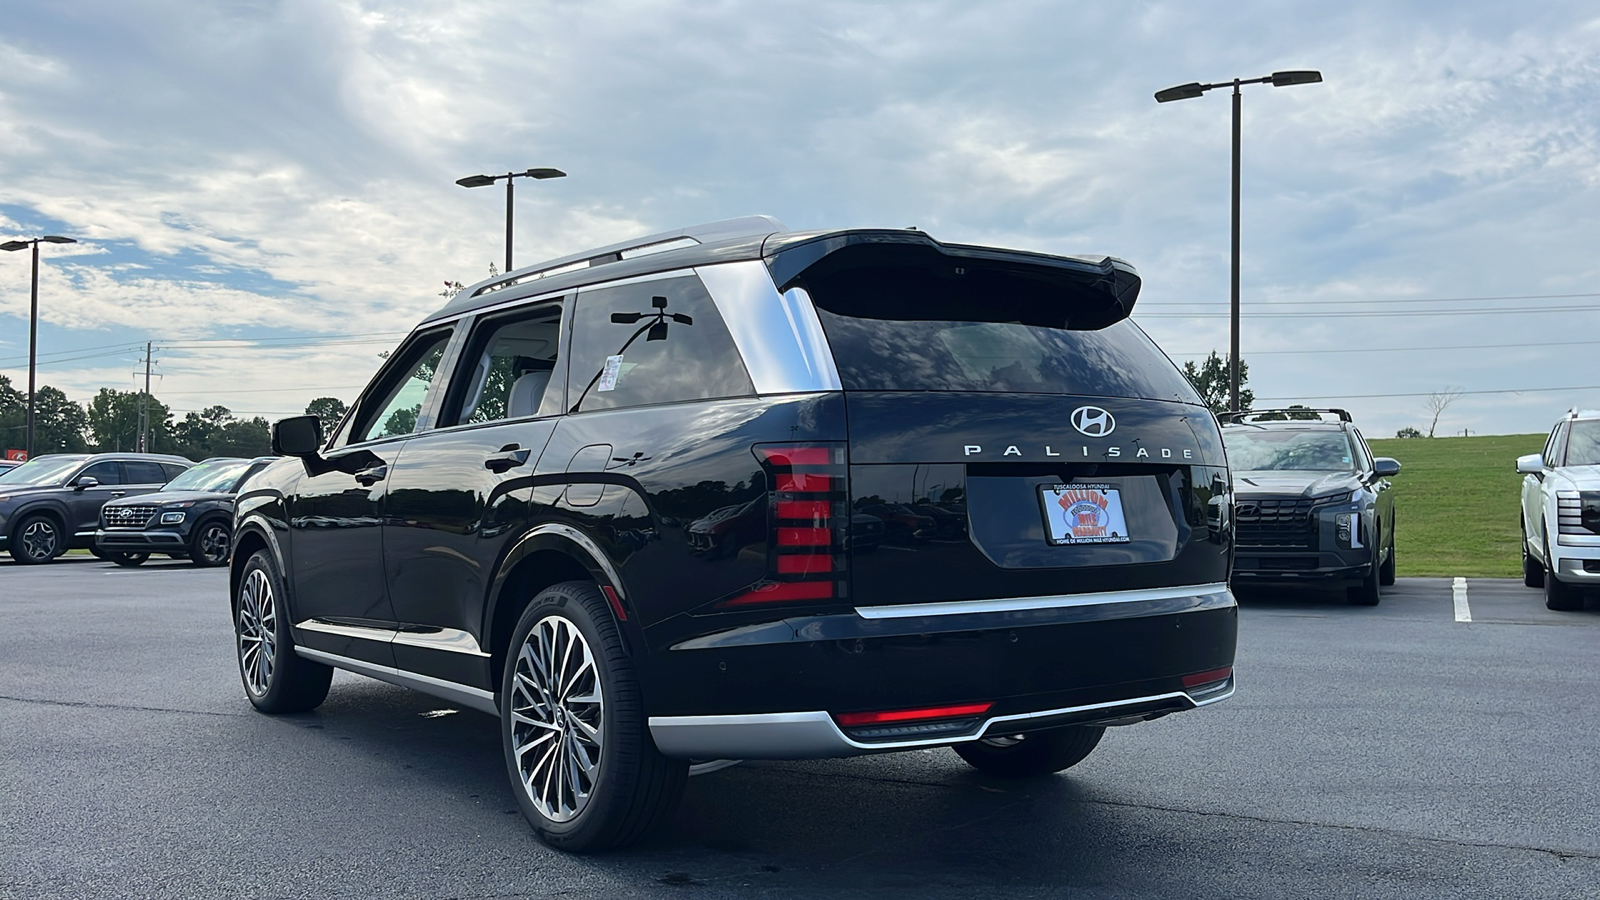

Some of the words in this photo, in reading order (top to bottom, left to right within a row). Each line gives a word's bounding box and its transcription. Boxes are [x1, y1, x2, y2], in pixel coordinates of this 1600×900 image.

[964, 445, 1193, 459] PALISADE
[1058, 489, 1108, 511] MILLION
[1077, 513, 1098, 526] MILE
[1072, 526, 1107, 537] WARRANTY
